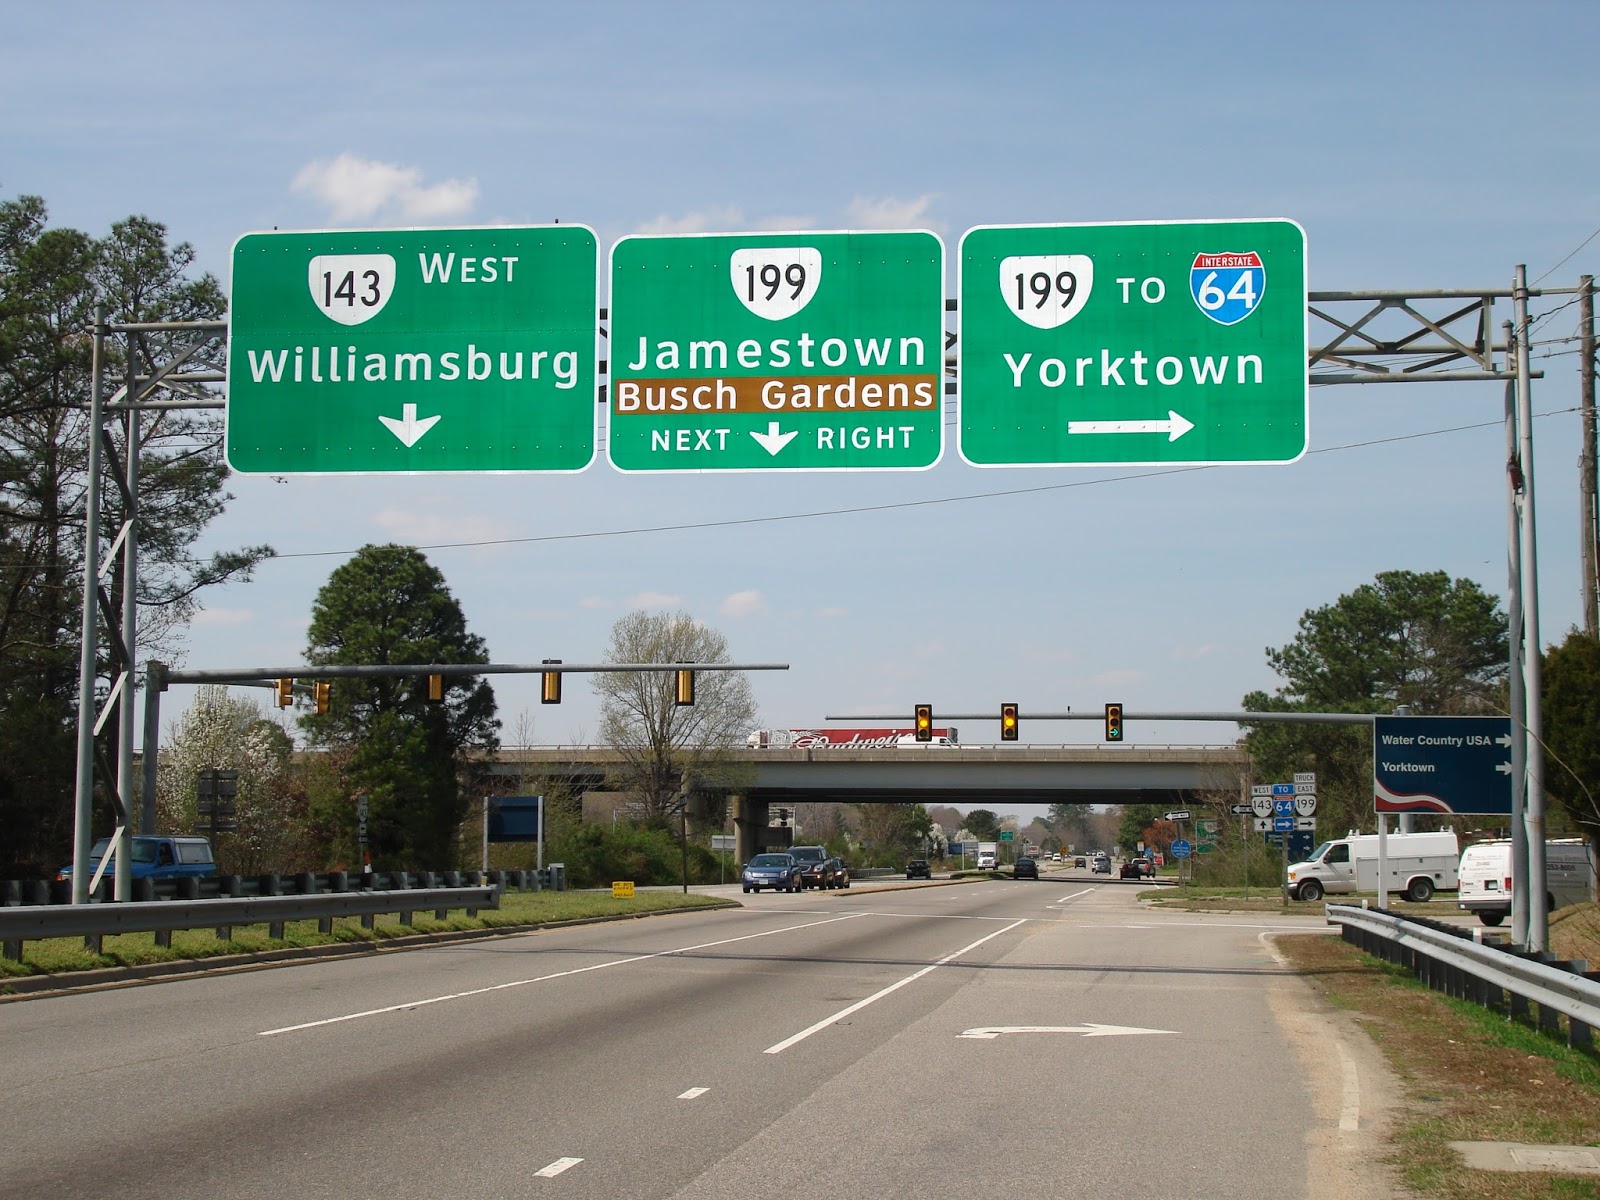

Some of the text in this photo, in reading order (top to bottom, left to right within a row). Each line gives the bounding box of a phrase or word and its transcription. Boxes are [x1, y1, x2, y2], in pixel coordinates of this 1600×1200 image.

[419, 252, 519, 284] WEST
[1201, 256, 1253, 267] INTERSTATE
[323, 270, 381, 307] 143
[746, 264, 806, 302] 199
[1015, 271, 1077, 310] 199
[1116, 277, 1166, 304] TO
[1199, 270, 1257, 311] 64
[247, 344, 578, 389] Williamsburg
[628, 333, 925, 371] Jamestown
[1003, 349, 1263, 388] Yorktown
[618, 376, 933, 411] Busch Gardens
[651, 426, 915, 451] NEXT RIGHT
[1381, 735, 1492, 748] Water Country USA
[1381, 761, 1436, 773] Yorktown
[1253, 800, 1272, 810] 143
[1276, 801, 1293, 812] 64
[1296, 799, 1315, 809] 199
